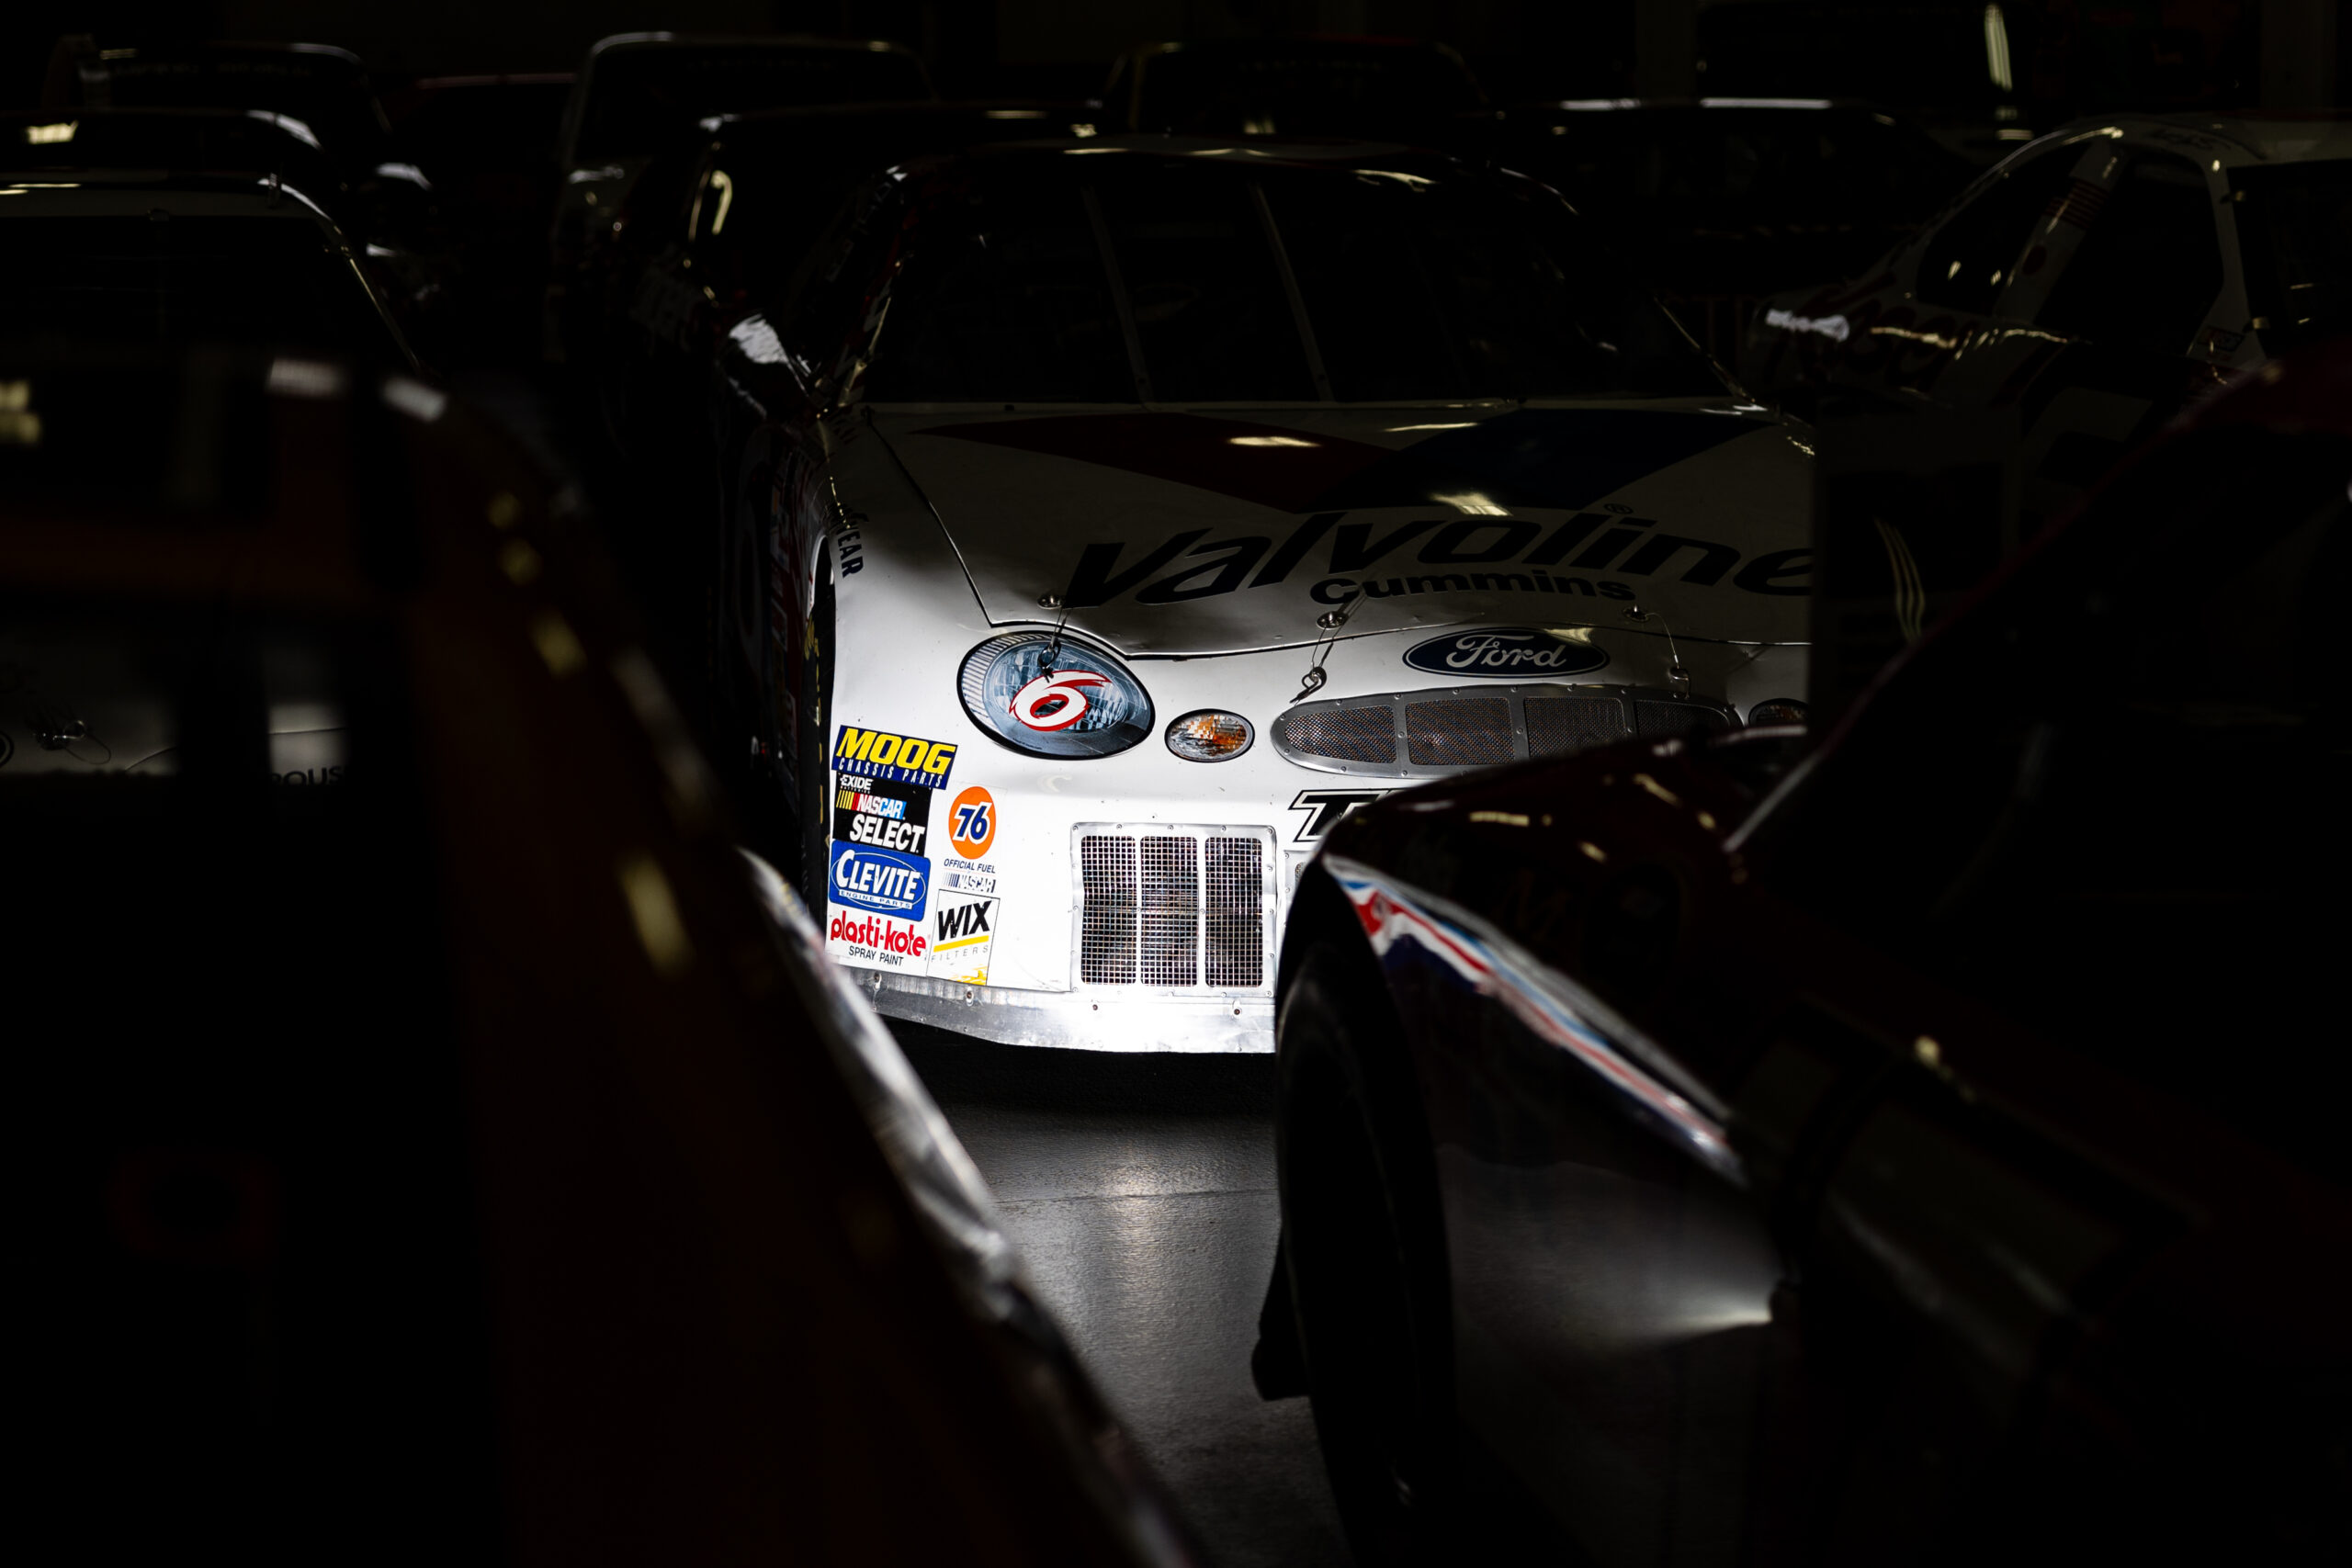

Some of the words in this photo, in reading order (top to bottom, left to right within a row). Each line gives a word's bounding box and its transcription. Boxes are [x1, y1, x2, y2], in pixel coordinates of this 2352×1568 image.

[1061, 512, 1815, 609] Valvoline
[1310, 570, 1636, 605] Cummins
[1445, 634, 1568, 669] Ford
[1009, 670, 1113, 732] 6
[835, 728, 956, 775] MOOG
[838, 757, 895, 779] CHASSIS
[901, 768, 944, 787] PARTS
[840, 774, 874, 790] EXIDE
[856, 793, 903, 819] NASCAR
[953, 802, 991, 844] 76
[849, 813, 926, 853] SELECT
[836, 849, 922, 900] CLEVITE
[944, 858, 975, 871] OFFICIAL
[977, 863, 996, 874] FUEL
[841, 891, 875, 903] ENGINE
[879, 897, 911, 909] PARTS
[830, 910, 927, 957] plasti-kote
[937, 900, 992, 942] WIX
[848, 945, 876, 961] SPRAY
[878, 952, 905, 967] PAINT
[931, 944, 989, 963] FILTERS
